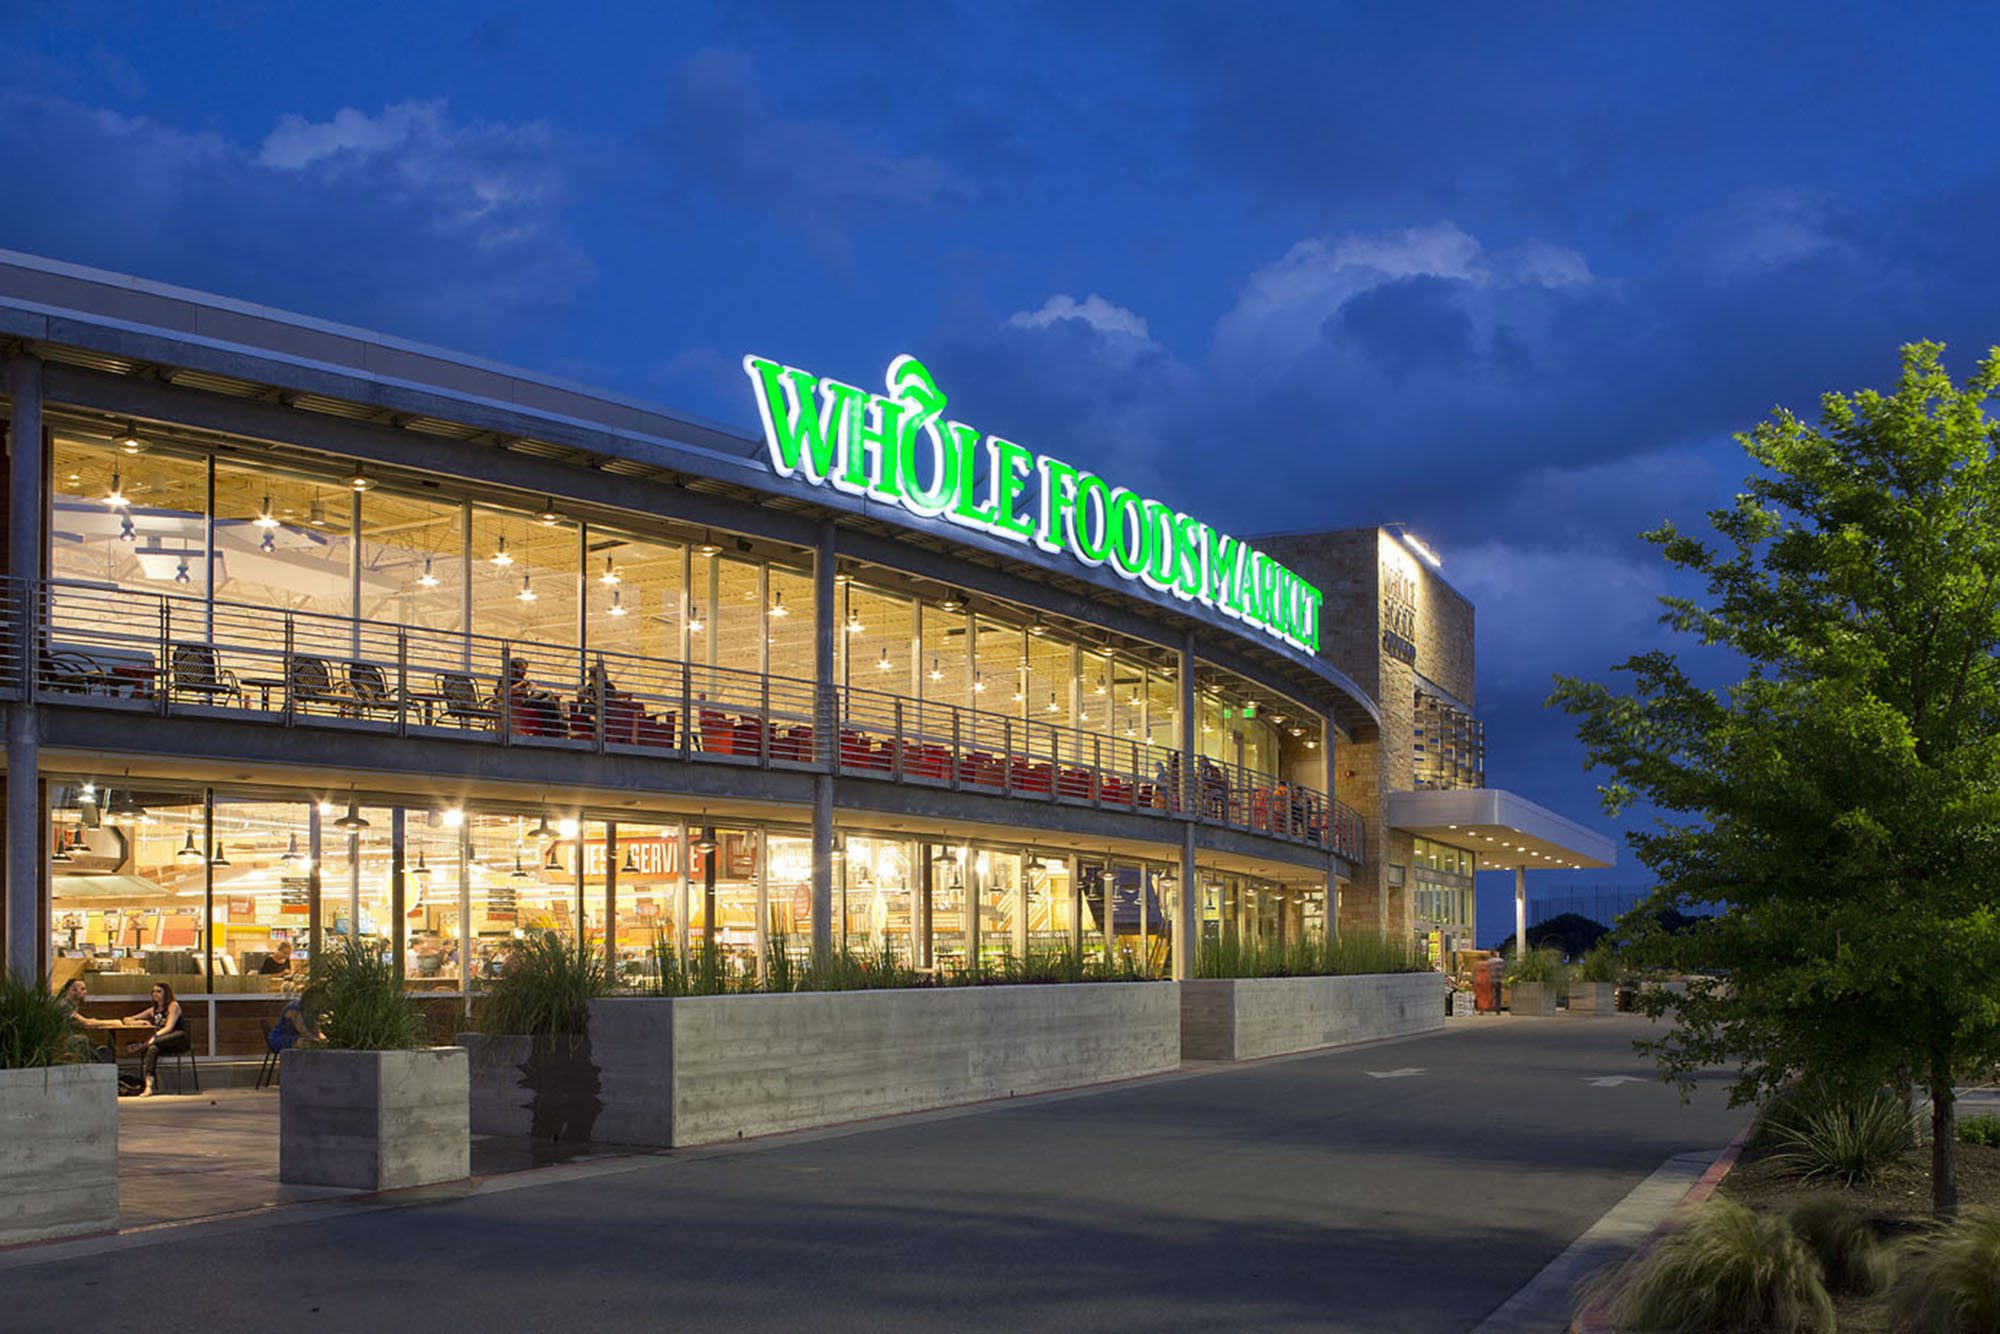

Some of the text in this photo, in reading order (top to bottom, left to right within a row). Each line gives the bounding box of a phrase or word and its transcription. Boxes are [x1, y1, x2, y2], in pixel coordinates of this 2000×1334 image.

[747, 356, 1323, 653] WHOLE FOODS MARKET
[630, 843, 700, 875] SERVIE
